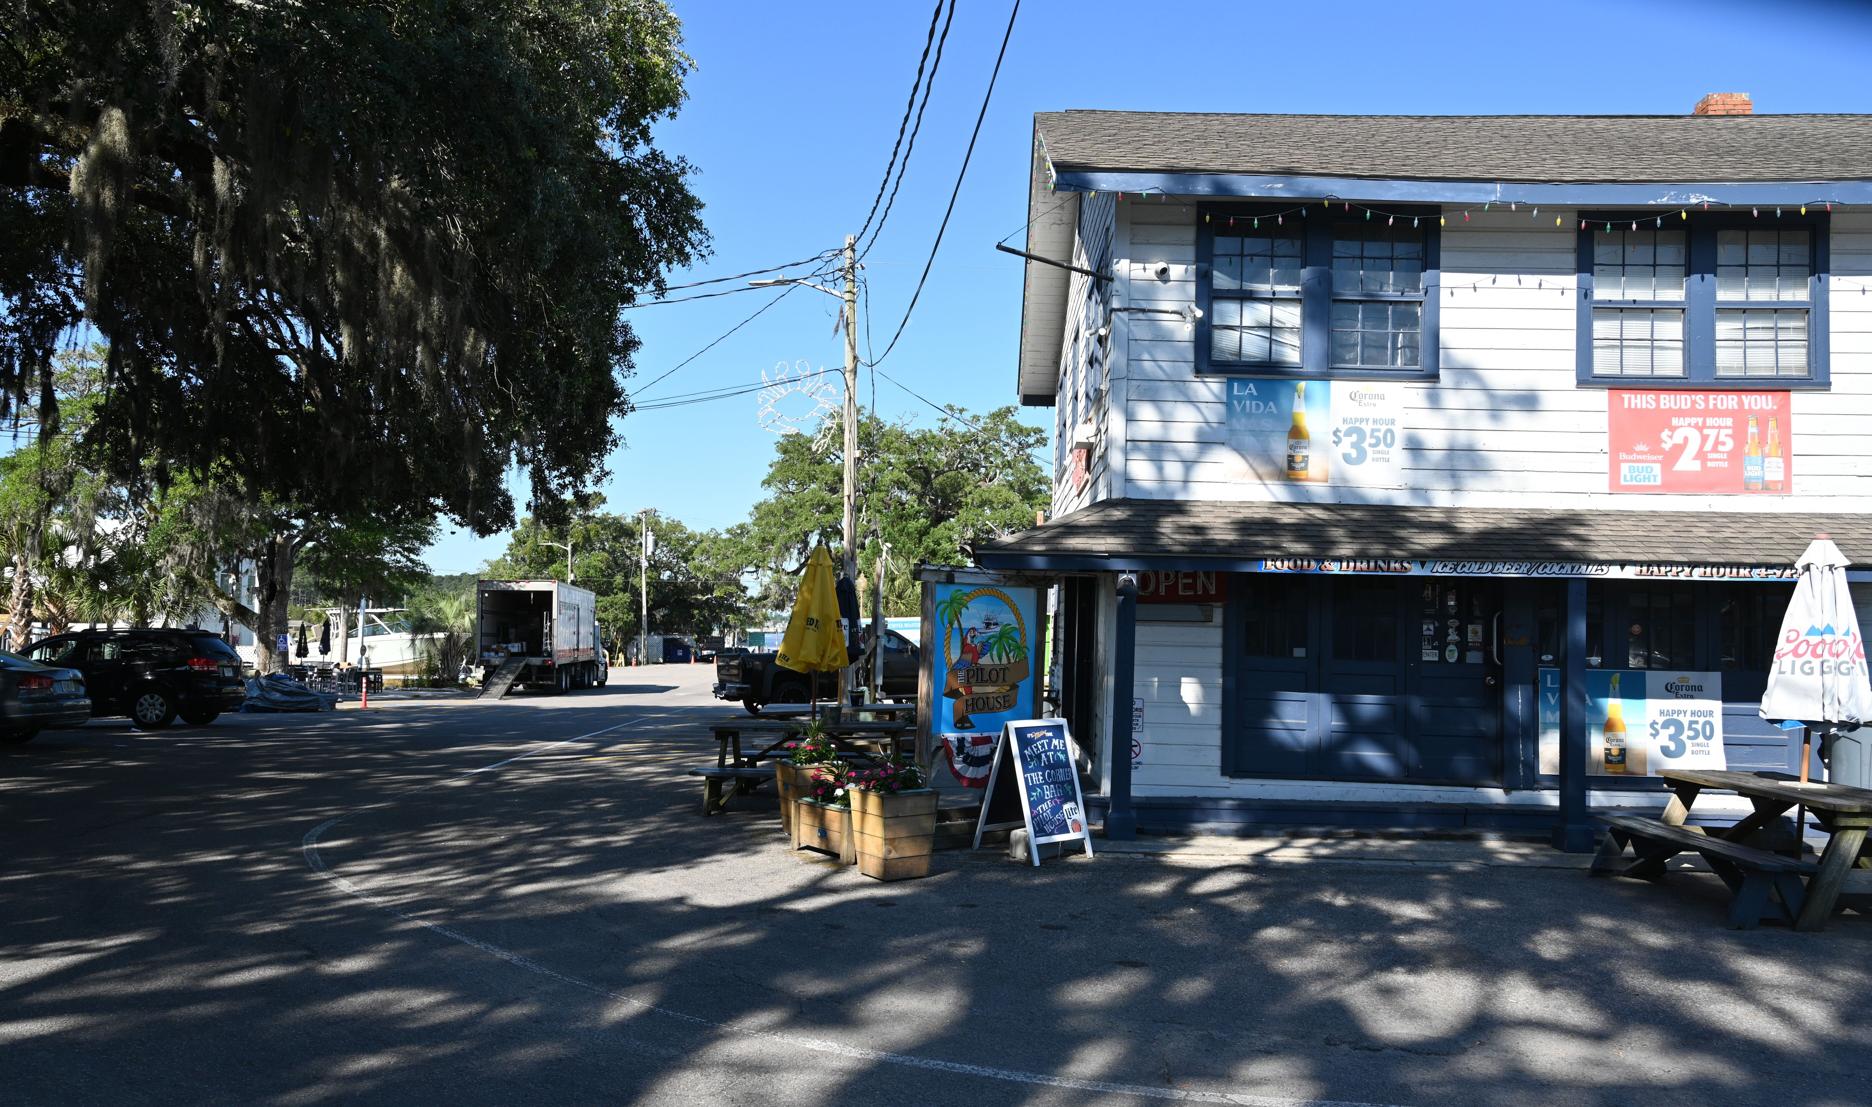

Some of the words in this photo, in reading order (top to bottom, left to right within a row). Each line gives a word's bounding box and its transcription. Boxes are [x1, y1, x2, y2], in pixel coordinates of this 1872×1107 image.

[1233, 382, 1258, 396] LA
[1349, 389, 1386, 402] Corona
[1233, 400, 1278, 414] VIDA
[1621, 394, 1656, 409] THIS
[1660, 394, 1705, 409] BUD'S
[1709, 395, 1738, 409] FOR
[1741, 395, 1777, 410] YOU.
[1342, 417, 1370, 426] HAPPY
[1372, 418, 1396, 426] HOUR
[1672, 417, 1702, 427] HAPPY
[1706, 417, 1733, 427] HOUR
[1619, 452, 1664, 461] Budweiser
[1628, 465, 1654, 474] BUD
[1623, 473, 1659, 483] LIGHT
[1263, 558, 1316, 571] FOOD
[1319, 559, 1336, 572] &
[1339, 559, 1413, 574] DRINKS
[1456, 560, 1493, 574] COLD
[1634, 563, 1695, 577] HAPPY
[1697, 564, 1756, 578] HOUR
[1136, 570, 1217, 596] OPEN
[967, 667, 1009, 684] PILOT
[1665, 681, 1704, 695] Corona
[1672, 690, 1695, 699] Extra
[965, 695, 1009, 711] HOUSE
[1659, 709, 1688, 718] HAPPY
[1690, 709, 1714, 718] HOUR
[1024, 739, 1049, 761] MEET
[1051, 738, 1066, 750] ME
[1041, 751, 1054, 766] AT
[1025, 771, 1045, 785] THE
[1045, 767, 1073, 782] CORNER
[1043, 784, 1063, 799] BAR
[1037, 799, 1052, 814] THE
[1064, 806, 1080, 820] Lite
[1044, 810, 1065, 833] HOUSE
